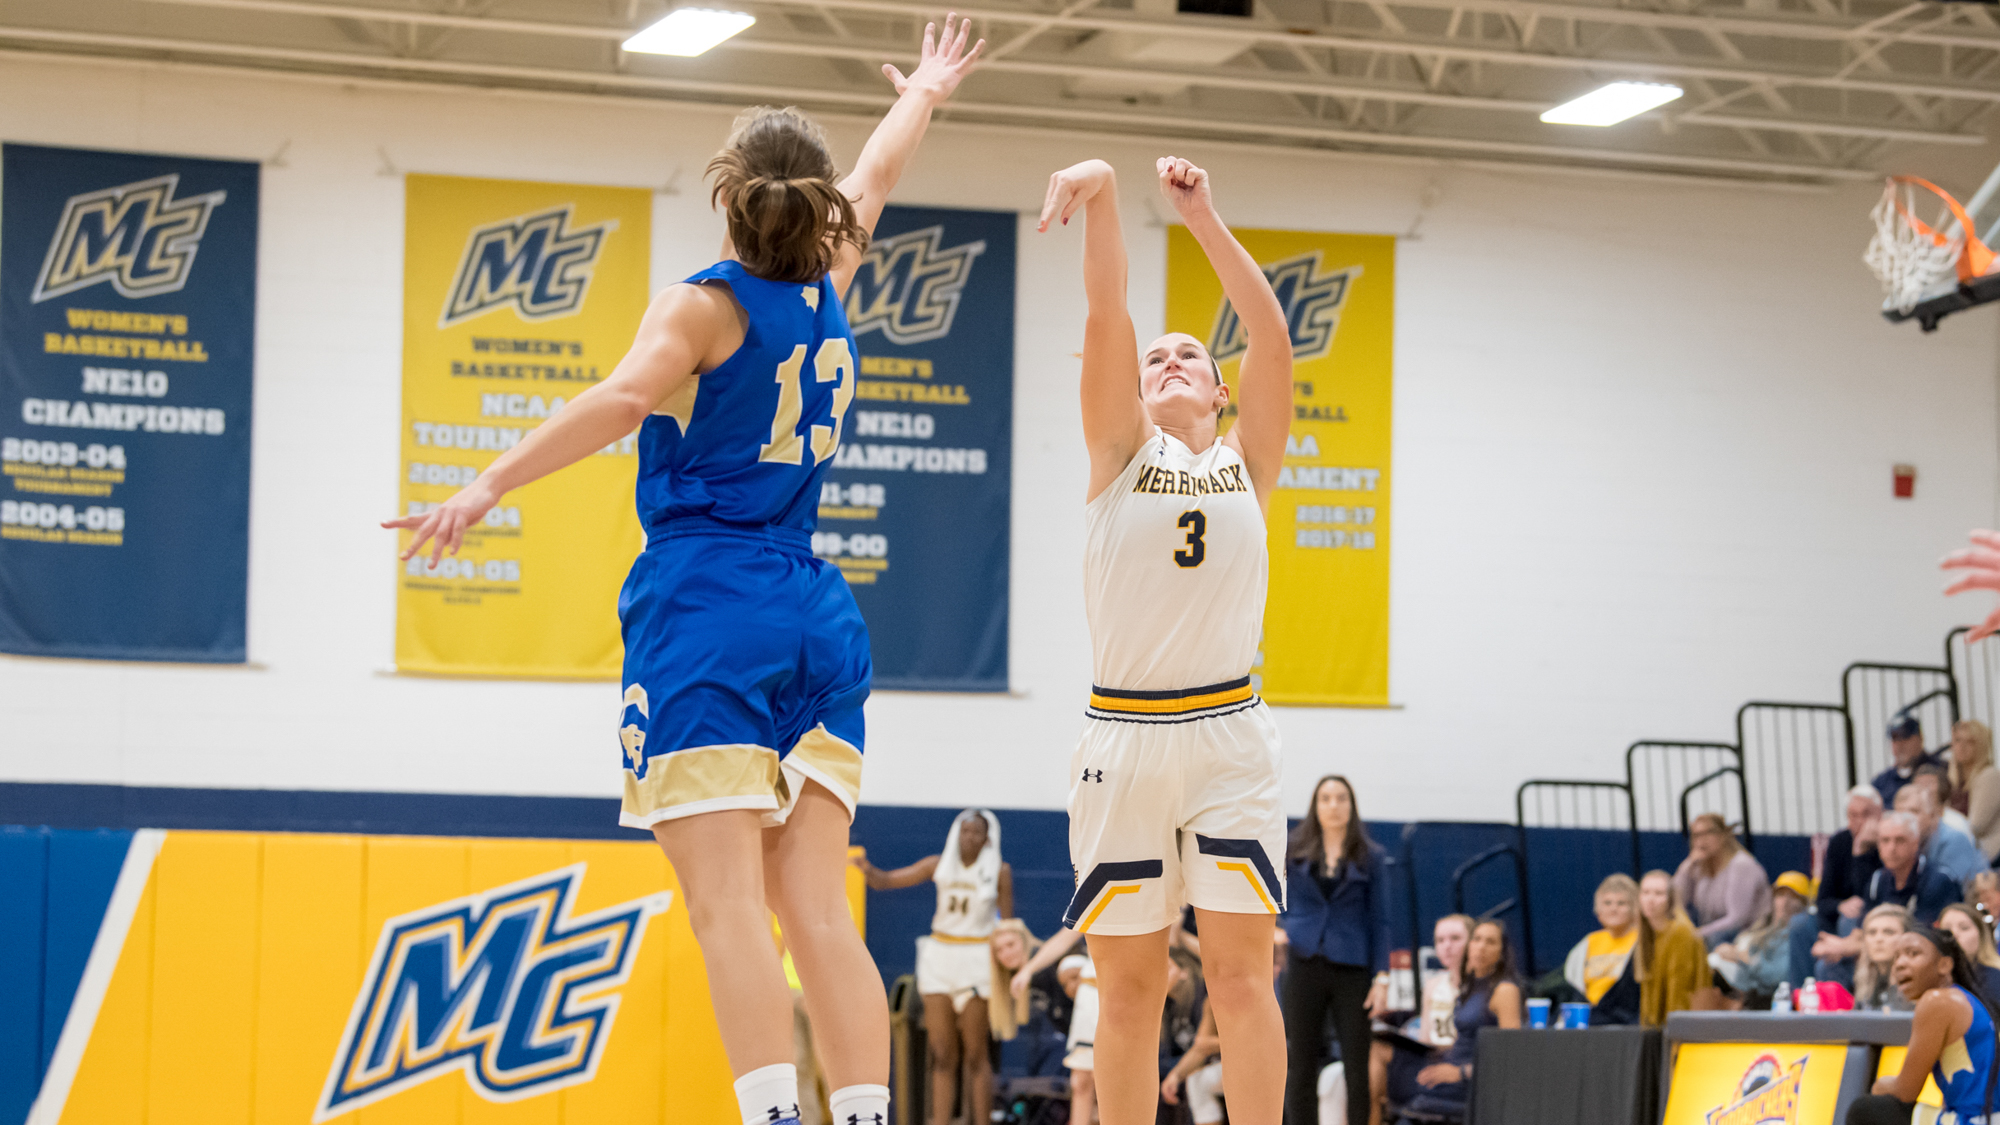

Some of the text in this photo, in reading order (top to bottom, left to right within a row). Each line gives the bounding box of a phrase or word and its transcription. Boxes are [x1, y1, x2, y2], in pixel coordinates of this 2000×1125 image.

[33, 174, 227, 303] MC
[438, 203, 620, 330] MC
[67, 309, 188, 334] WOMEN'S
[44, 333, 208, 362] BASKETBALL
[471, 335, 583, 357] WOMEN'S
[82, 367, 168, 398] NE10
[451, 361, 603, 383] BASKETBALL
[22, 399, 226, 435] CHAMPIONS
[758, 337, 855, 467] 13
[856, 411, 935, 440] NE10
[3, 437, 127, 470] 2003-04
[1, 500, 125, 532] 2004-05
[1173, 508, 1207, 570] 3
[312, 861, 673, 1124] MC
